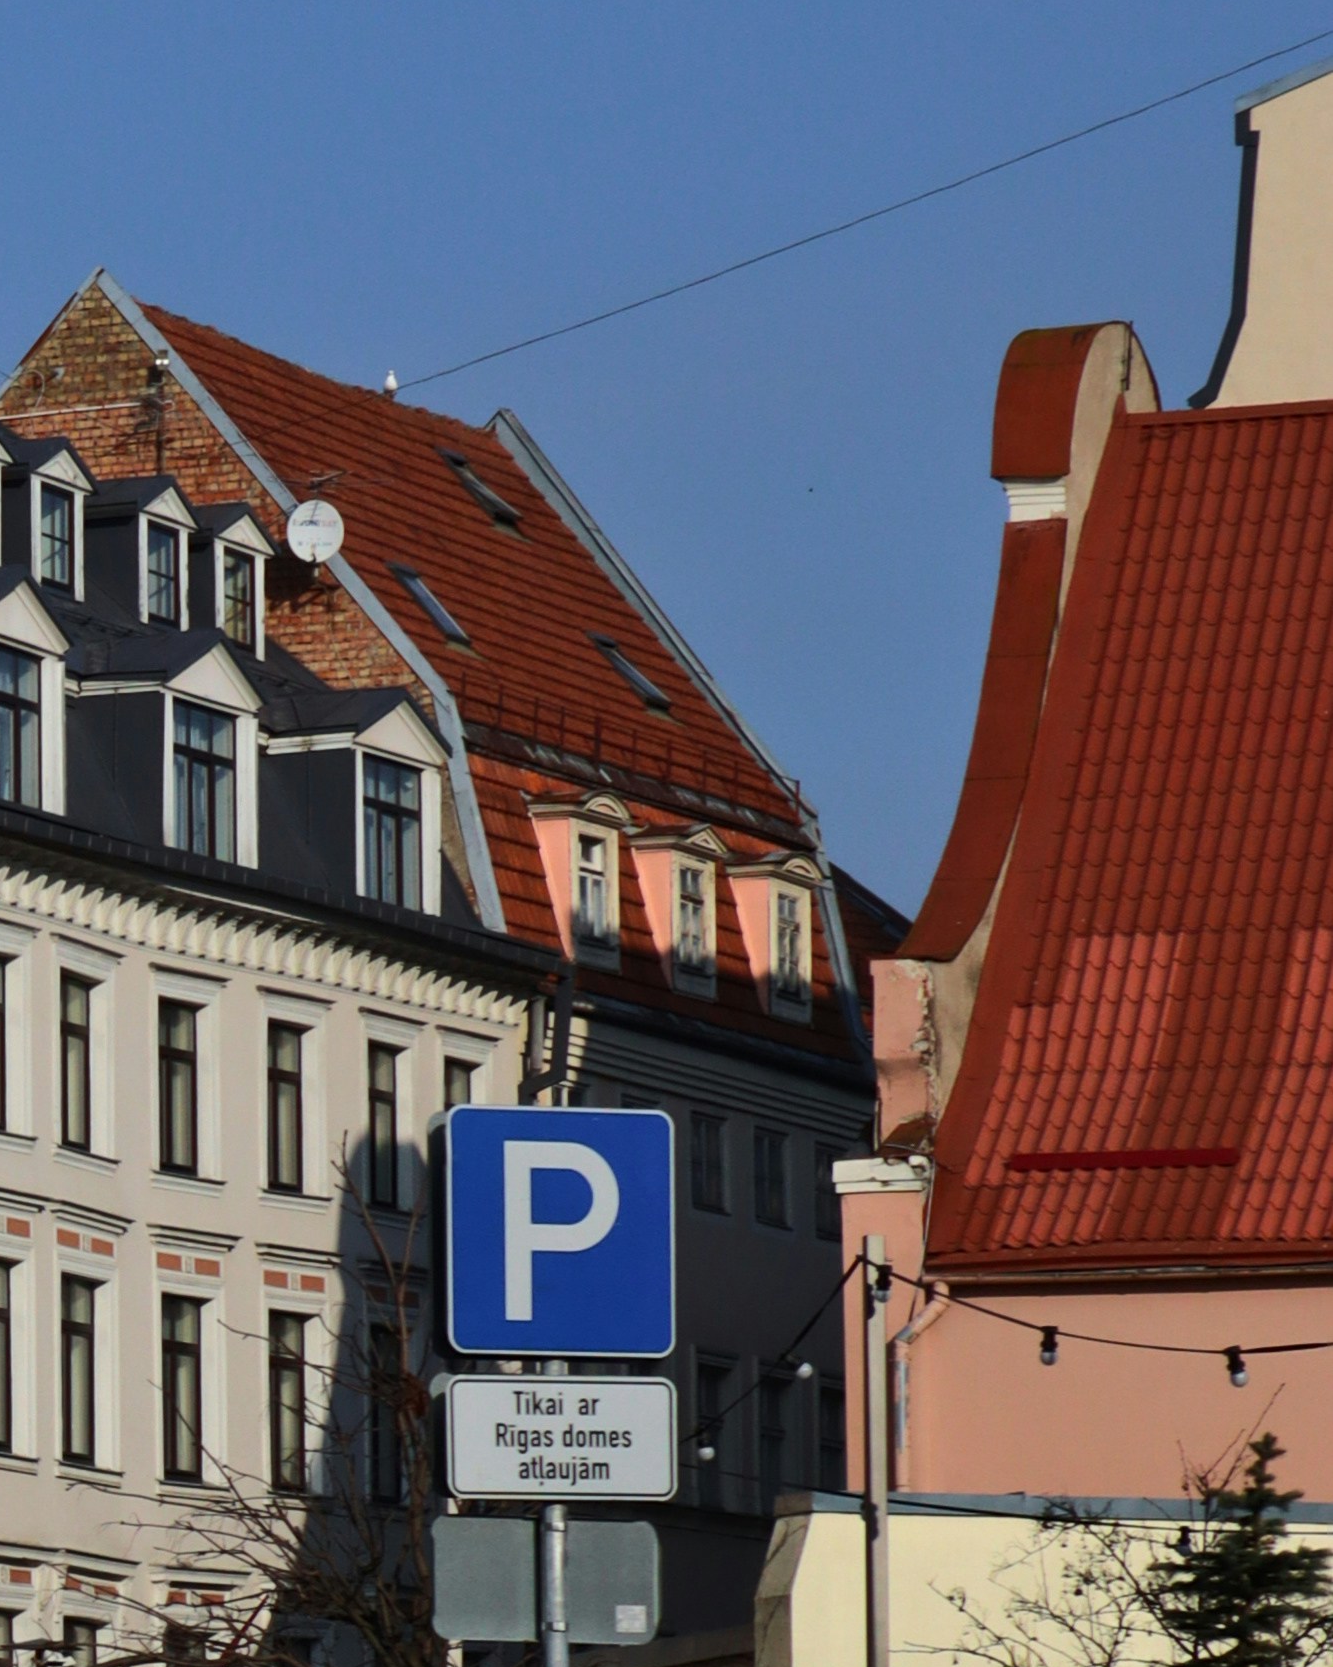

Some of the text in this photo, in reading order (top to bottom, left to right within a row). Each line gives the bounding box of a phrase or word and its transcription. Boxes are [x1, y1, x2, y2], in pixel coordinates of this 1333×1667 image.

[503, 1140, 620, 1321] P
[513, 1390, 600, 1416] Tikai ar
[496, 1423, 632, 1454] Rīgas domes
[519, 1455, 610, 1486] atļaujām
